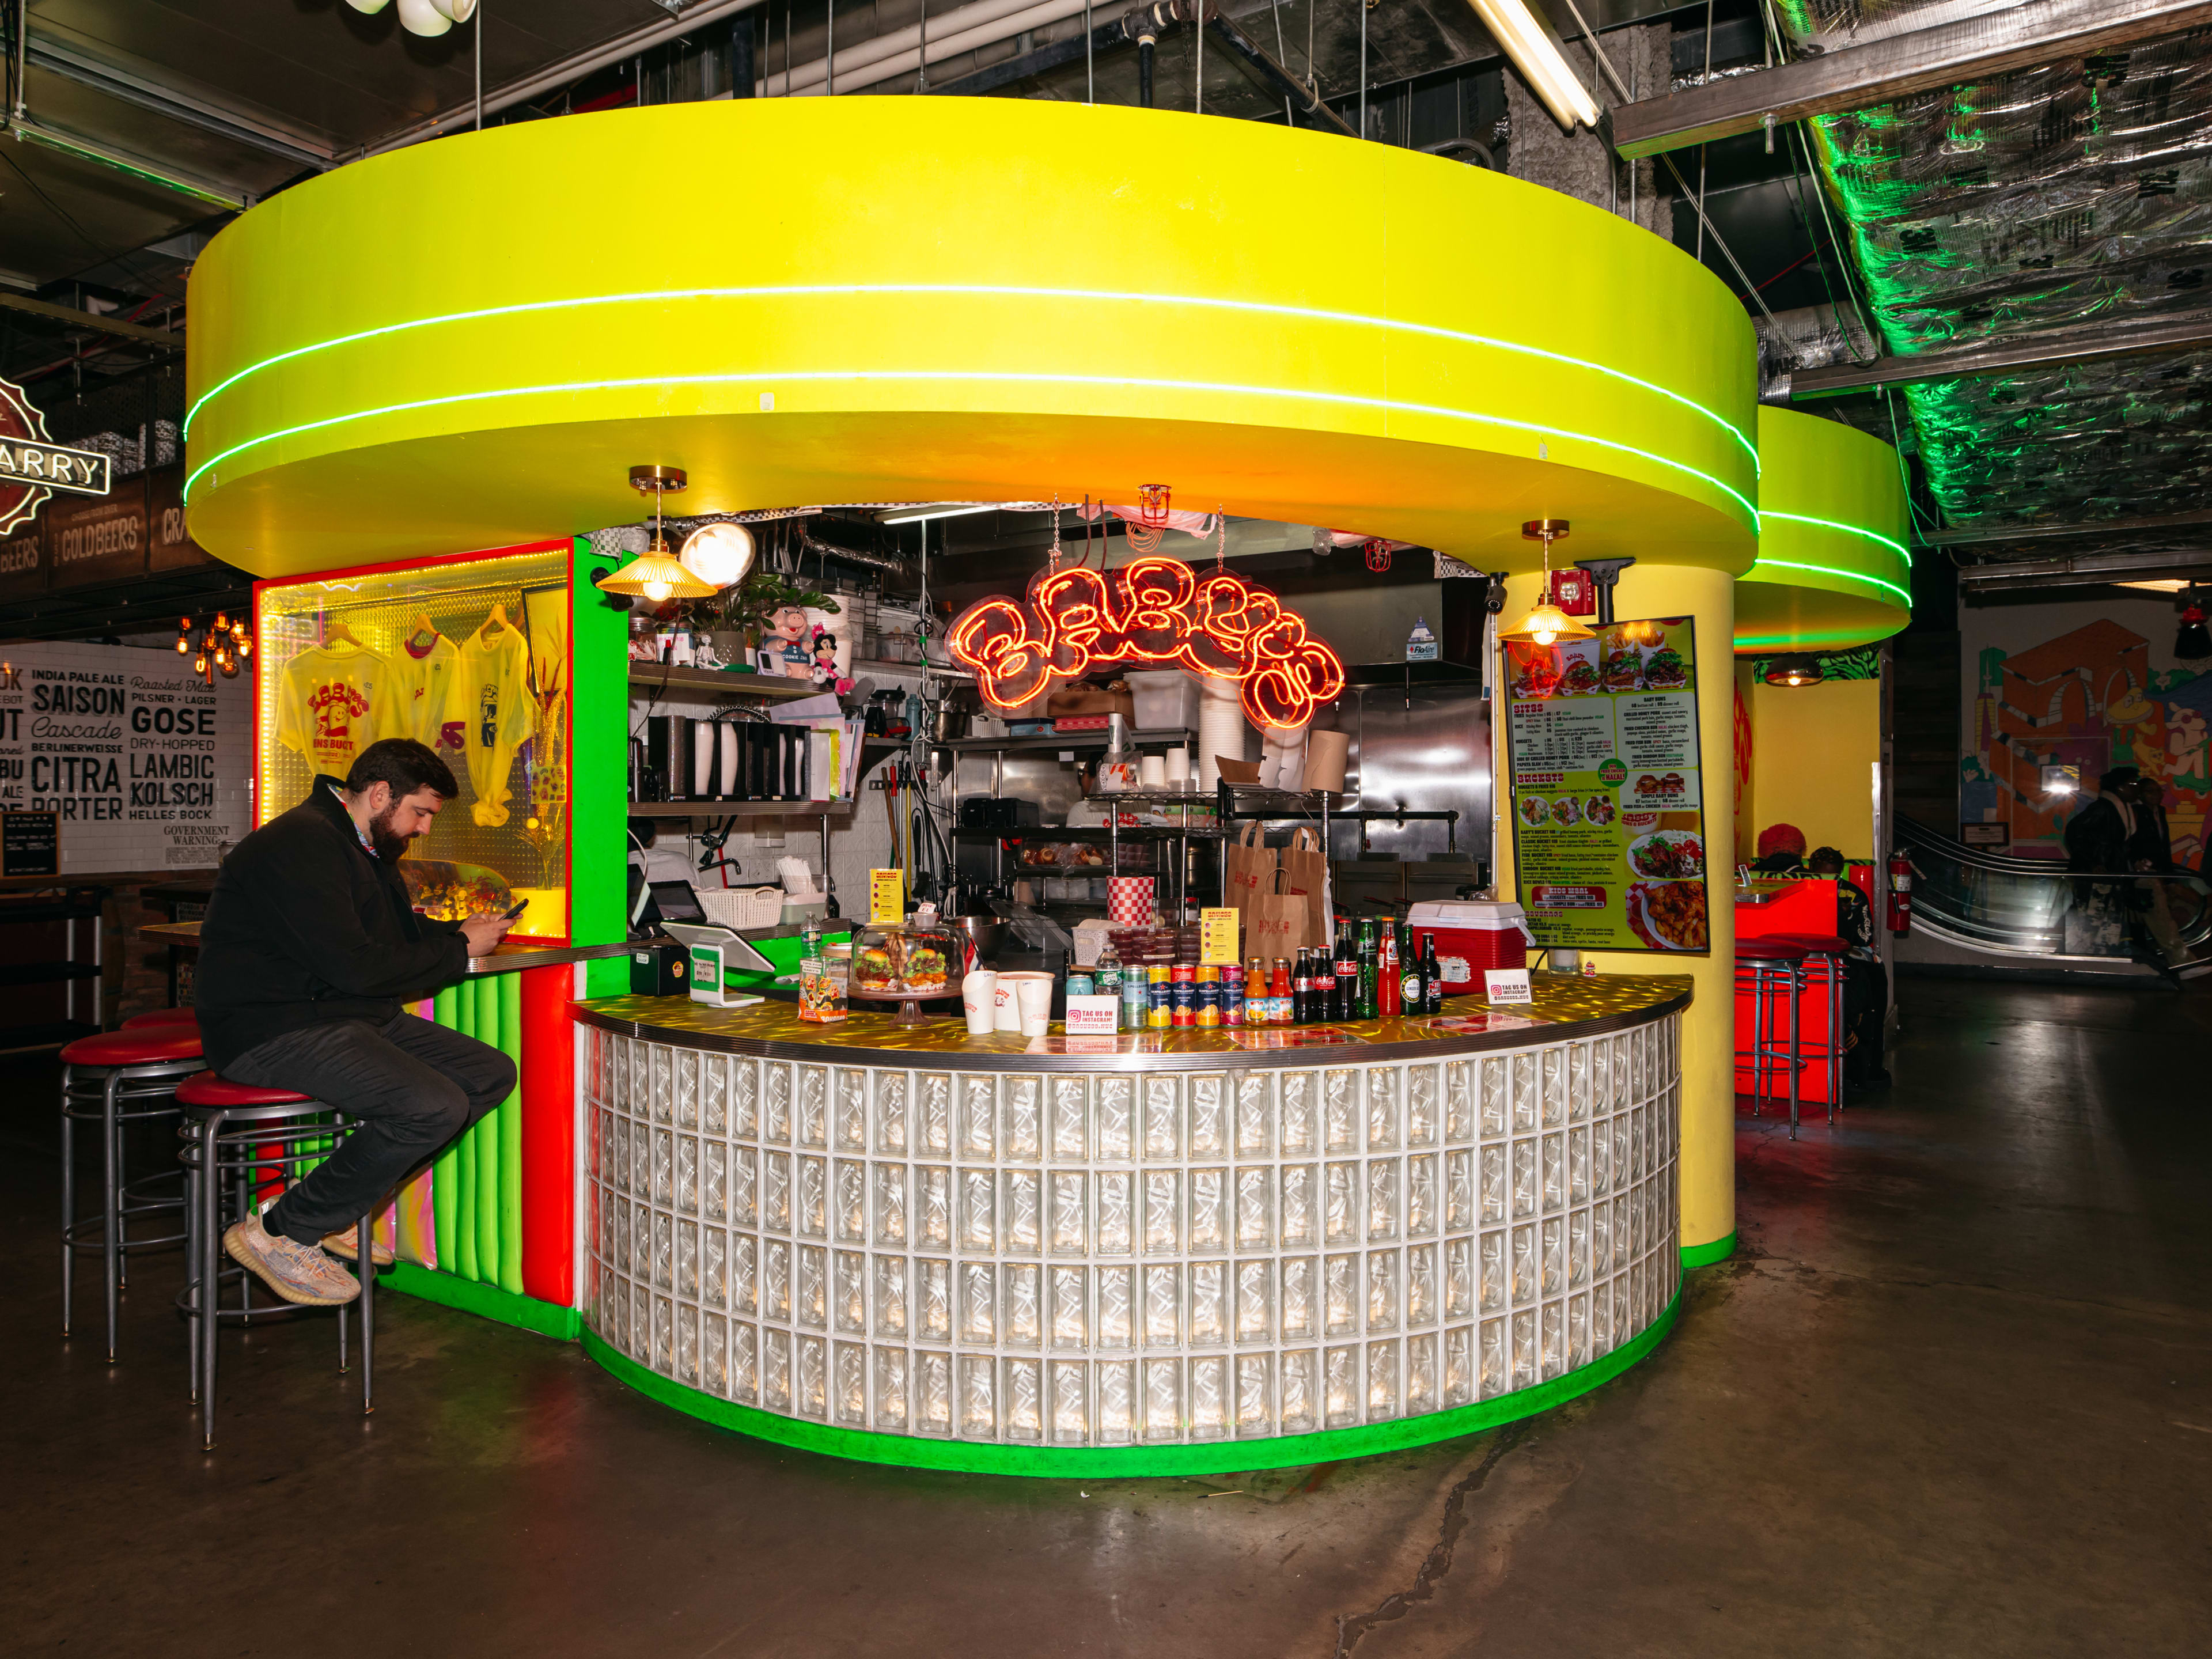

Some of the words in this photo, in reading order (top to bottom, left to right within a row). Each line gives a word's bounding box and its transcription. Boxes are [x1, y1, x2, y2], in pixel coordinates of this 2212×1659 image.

[32, 670, 66, 681] INDIA
[69, 672, 100, 683] PALE
[101, 673, 124, 684] ALE
[131, 676, 183, 691] Roasted
[33, 684, 124, 715] SAISON
[132, 693, 174, 703] PILSNER
[185, 695, 217, 705] LAGER
[1514, 704, 1543, 713] BITES
[32, 716, 122, 740] Cascade
[131, 706, 216, 735] GOSE
[130, 737, 215, 751] DRY-HOPPED
[130, 753, 214, 779] LAMBIC
[32, 756, 122, 793] CITRA
[130, 782, 213, 806] KOLSCH
[129, 810, 175, 820] HELLES
[180, 810, 212, 820] BOCK
[164, 825, 229, 835] GOVERNMENT
